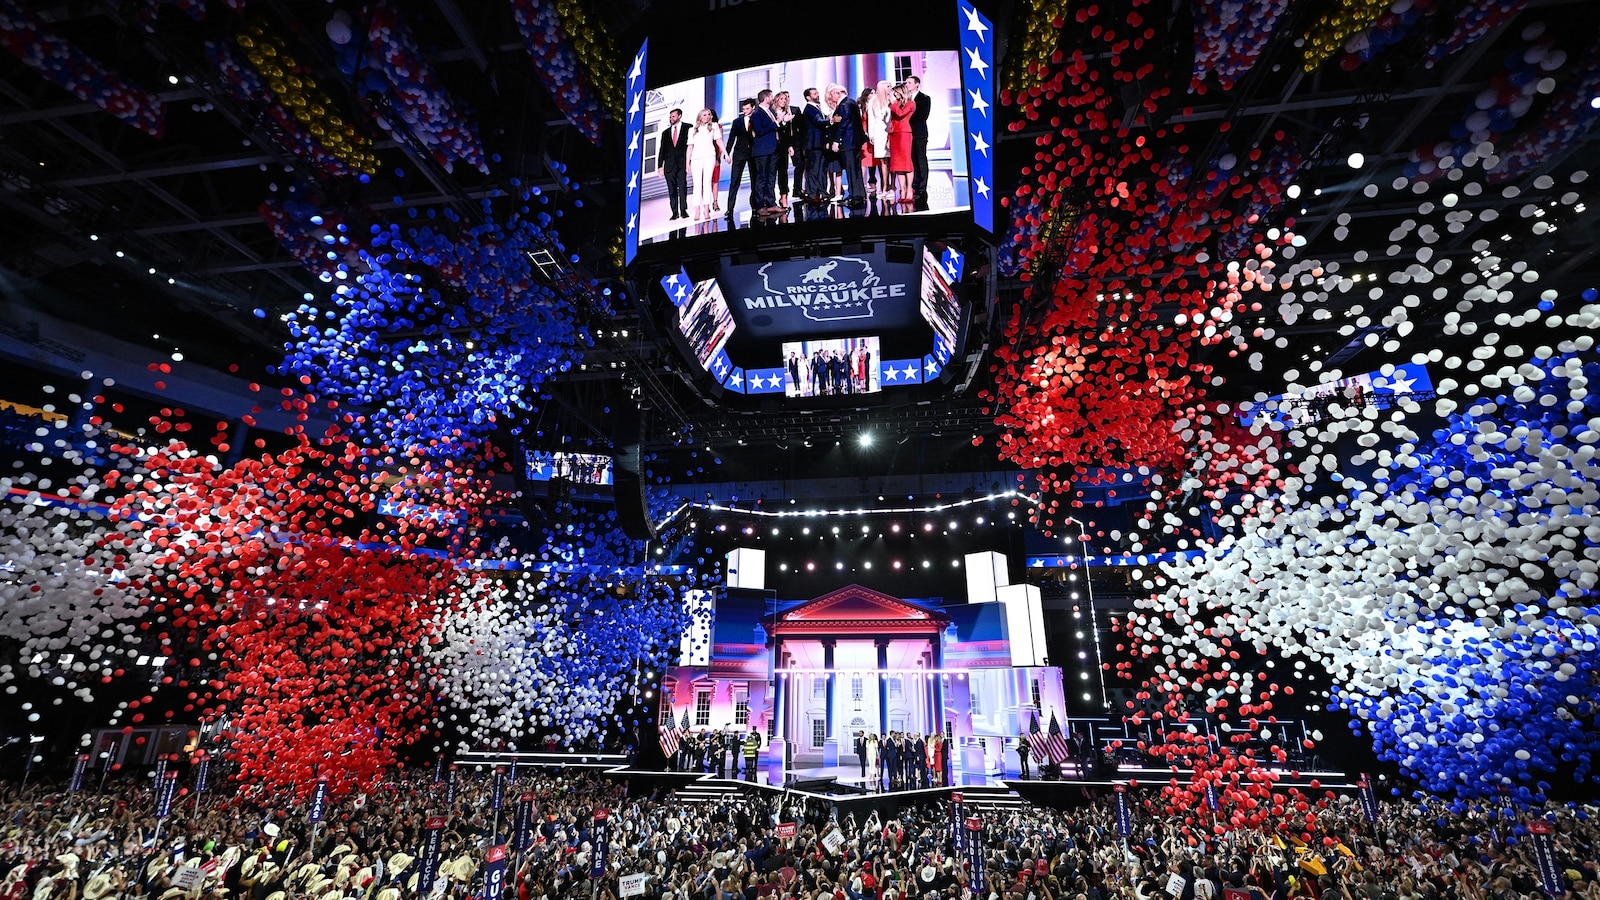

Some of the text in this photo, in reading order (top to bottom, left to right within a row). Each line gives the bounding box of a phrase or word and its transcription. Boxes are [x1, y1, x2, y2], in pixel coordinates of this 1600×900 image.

[744, 284, 906, 309] MILWAUKEE
[786, 281, 858, 294] RNC 2024
[156, 780, 169, 816] ALABAMA
[313, 784, 324, 819] TEXAS
[954, 803, 962, 848] FLORIDA
[422, 830, 438, 888] KENTUCKY
[594, 826, 604, 868] MAINE
[968, 832, 976, 889] INDIANA
[1540, 835, 1561, 893] MINNESOTA
[489, 869, 501, 900] GU
[622, 878, 642, 886] TRUMP
